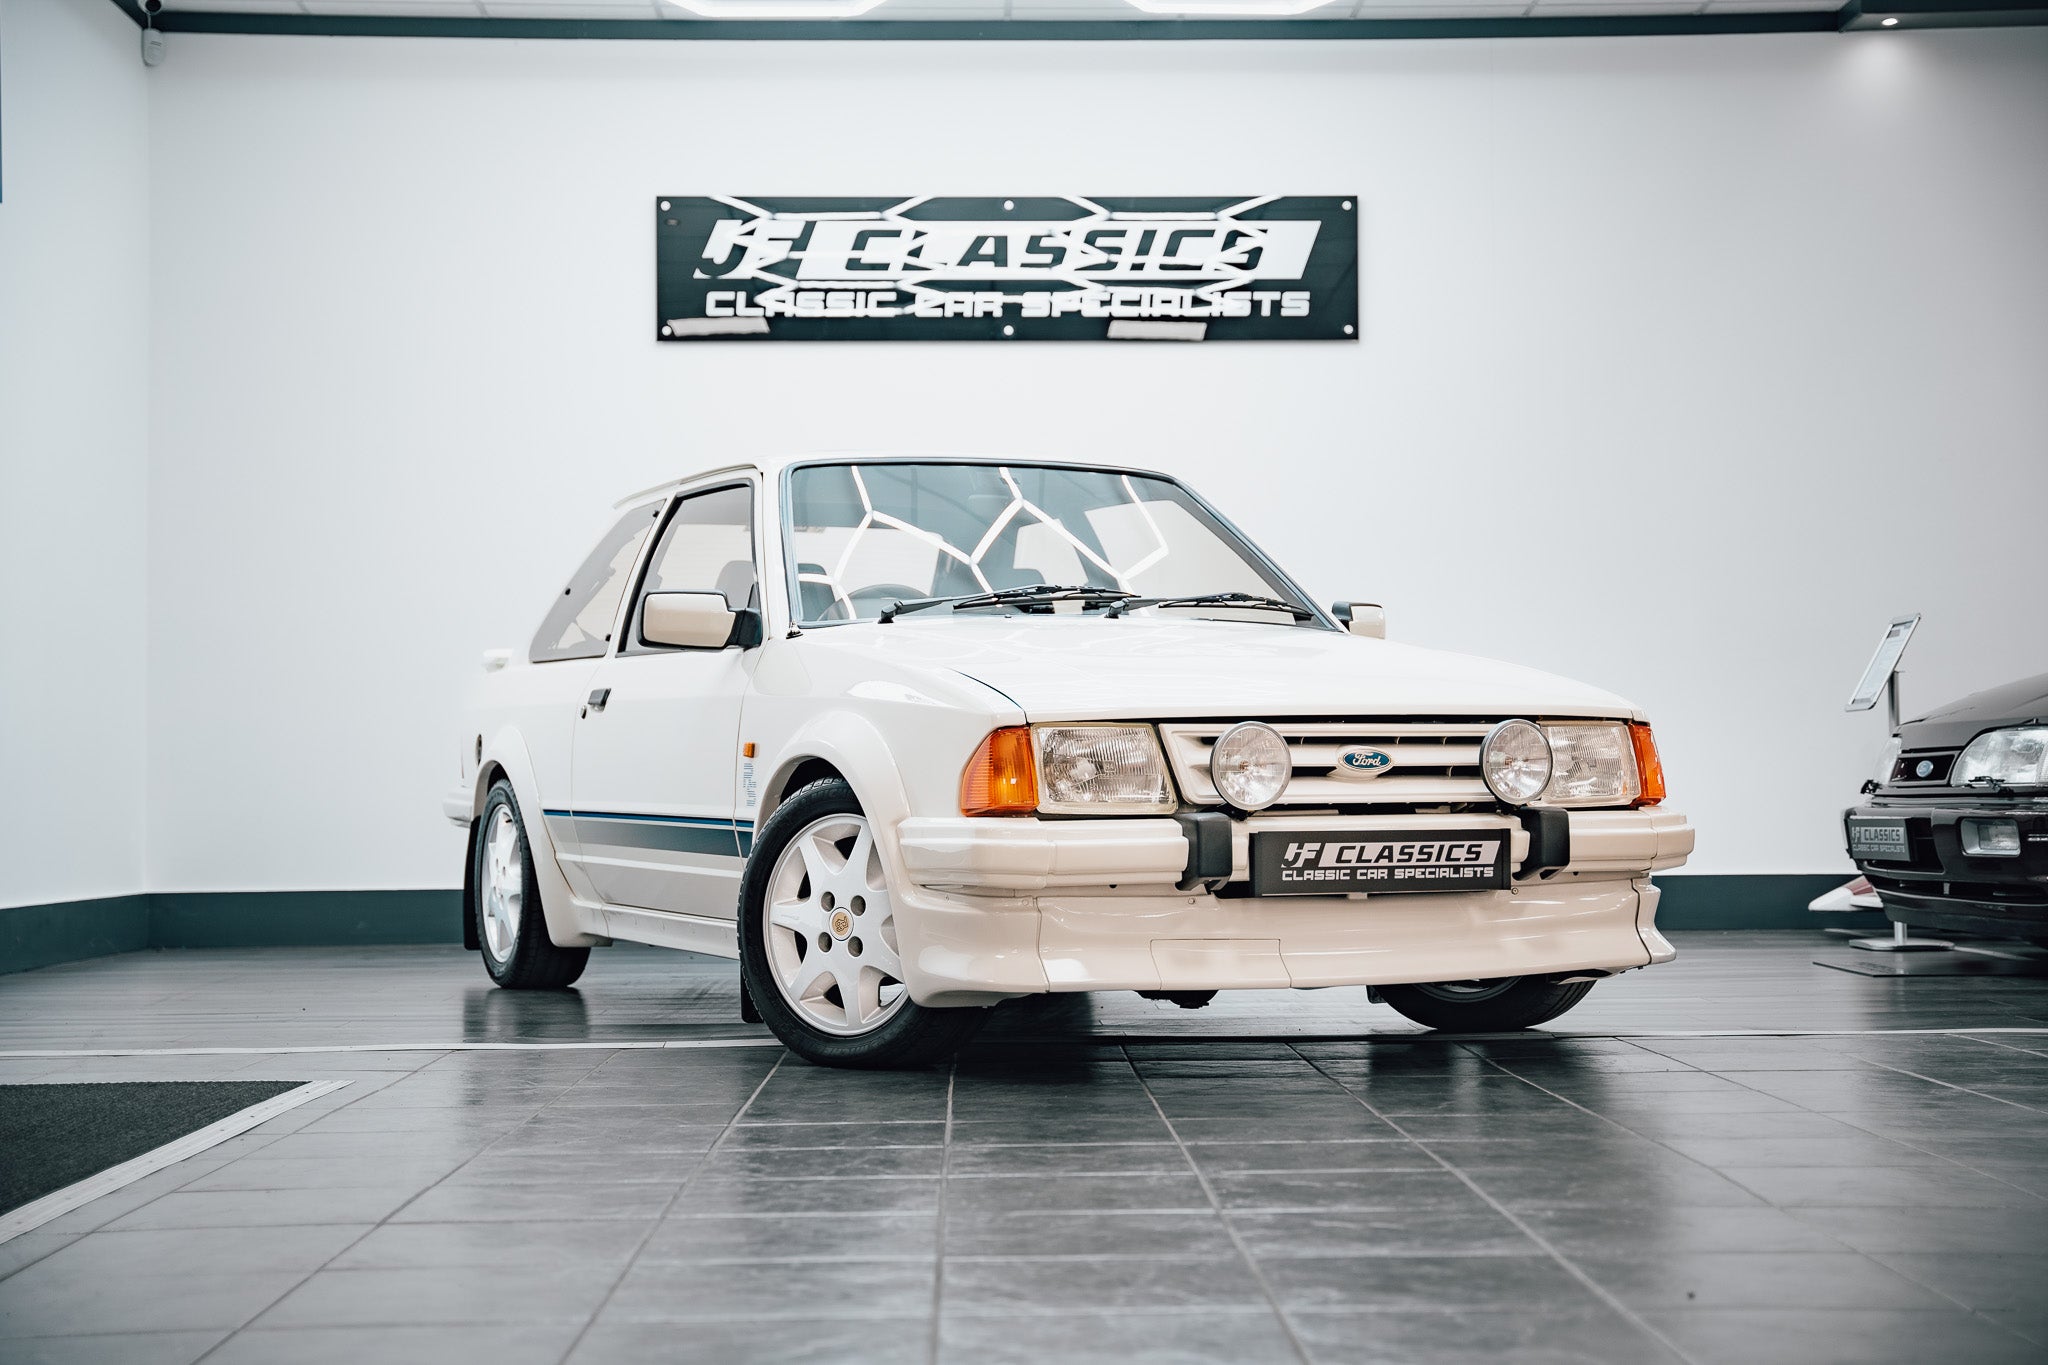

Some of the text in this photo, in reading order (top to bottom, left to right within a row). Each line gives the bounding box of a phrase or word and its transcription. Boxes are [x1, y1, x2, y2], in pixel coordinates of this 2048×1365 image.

[693, 219, 1265, 279] JF CLASSICS
[705, 290, 1311, 318] CLASSIC CAR SPECIALISTS
[1353, 751, 1382, 766] Ford
[1864, 829, 1900, 841] CLASSICS
[1281, 842, 1483, 868] JF CLASSICS
[1282, 867, 1494, 881] CLASSIC CAR SPECIALISTS
